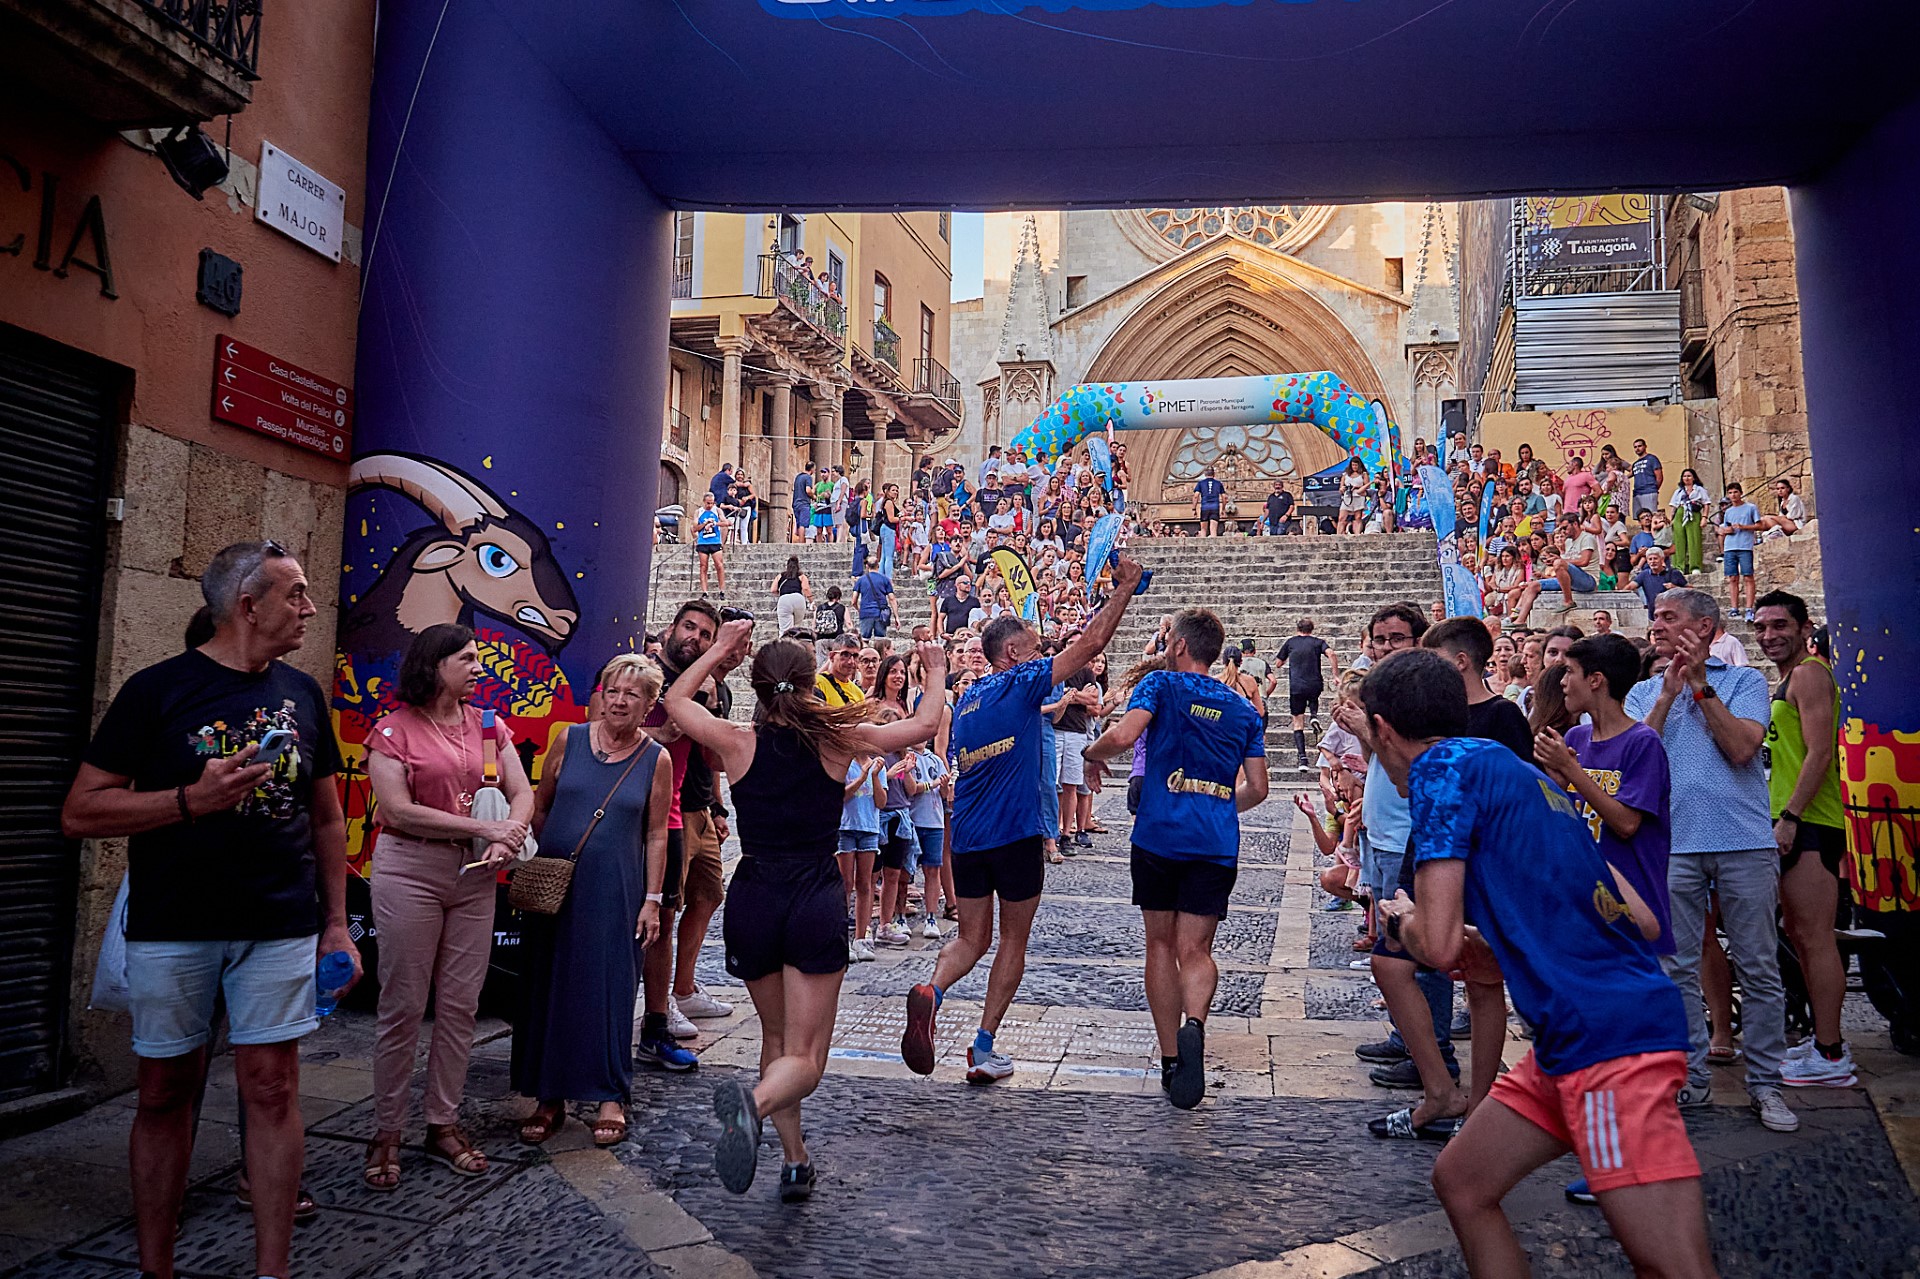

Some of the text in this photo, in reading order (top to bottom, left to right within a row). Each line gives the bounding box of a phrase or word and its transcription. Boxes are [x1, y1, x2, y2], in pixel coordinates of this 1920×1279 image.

[287, 169, 326, 201] CARRER
[279, 203, 327, 243] MAJOR
[269, 361, 333, 397] Casa Castellarnau
[281, 390, 332, 419] Volta del Pallol
[1158, 400, 1196, 413] PMET
[256, 416, 288, 438] Passeig
[296, 417, 327, 437] Muralles
[1190, 703, 1222, 723] VOLKER
